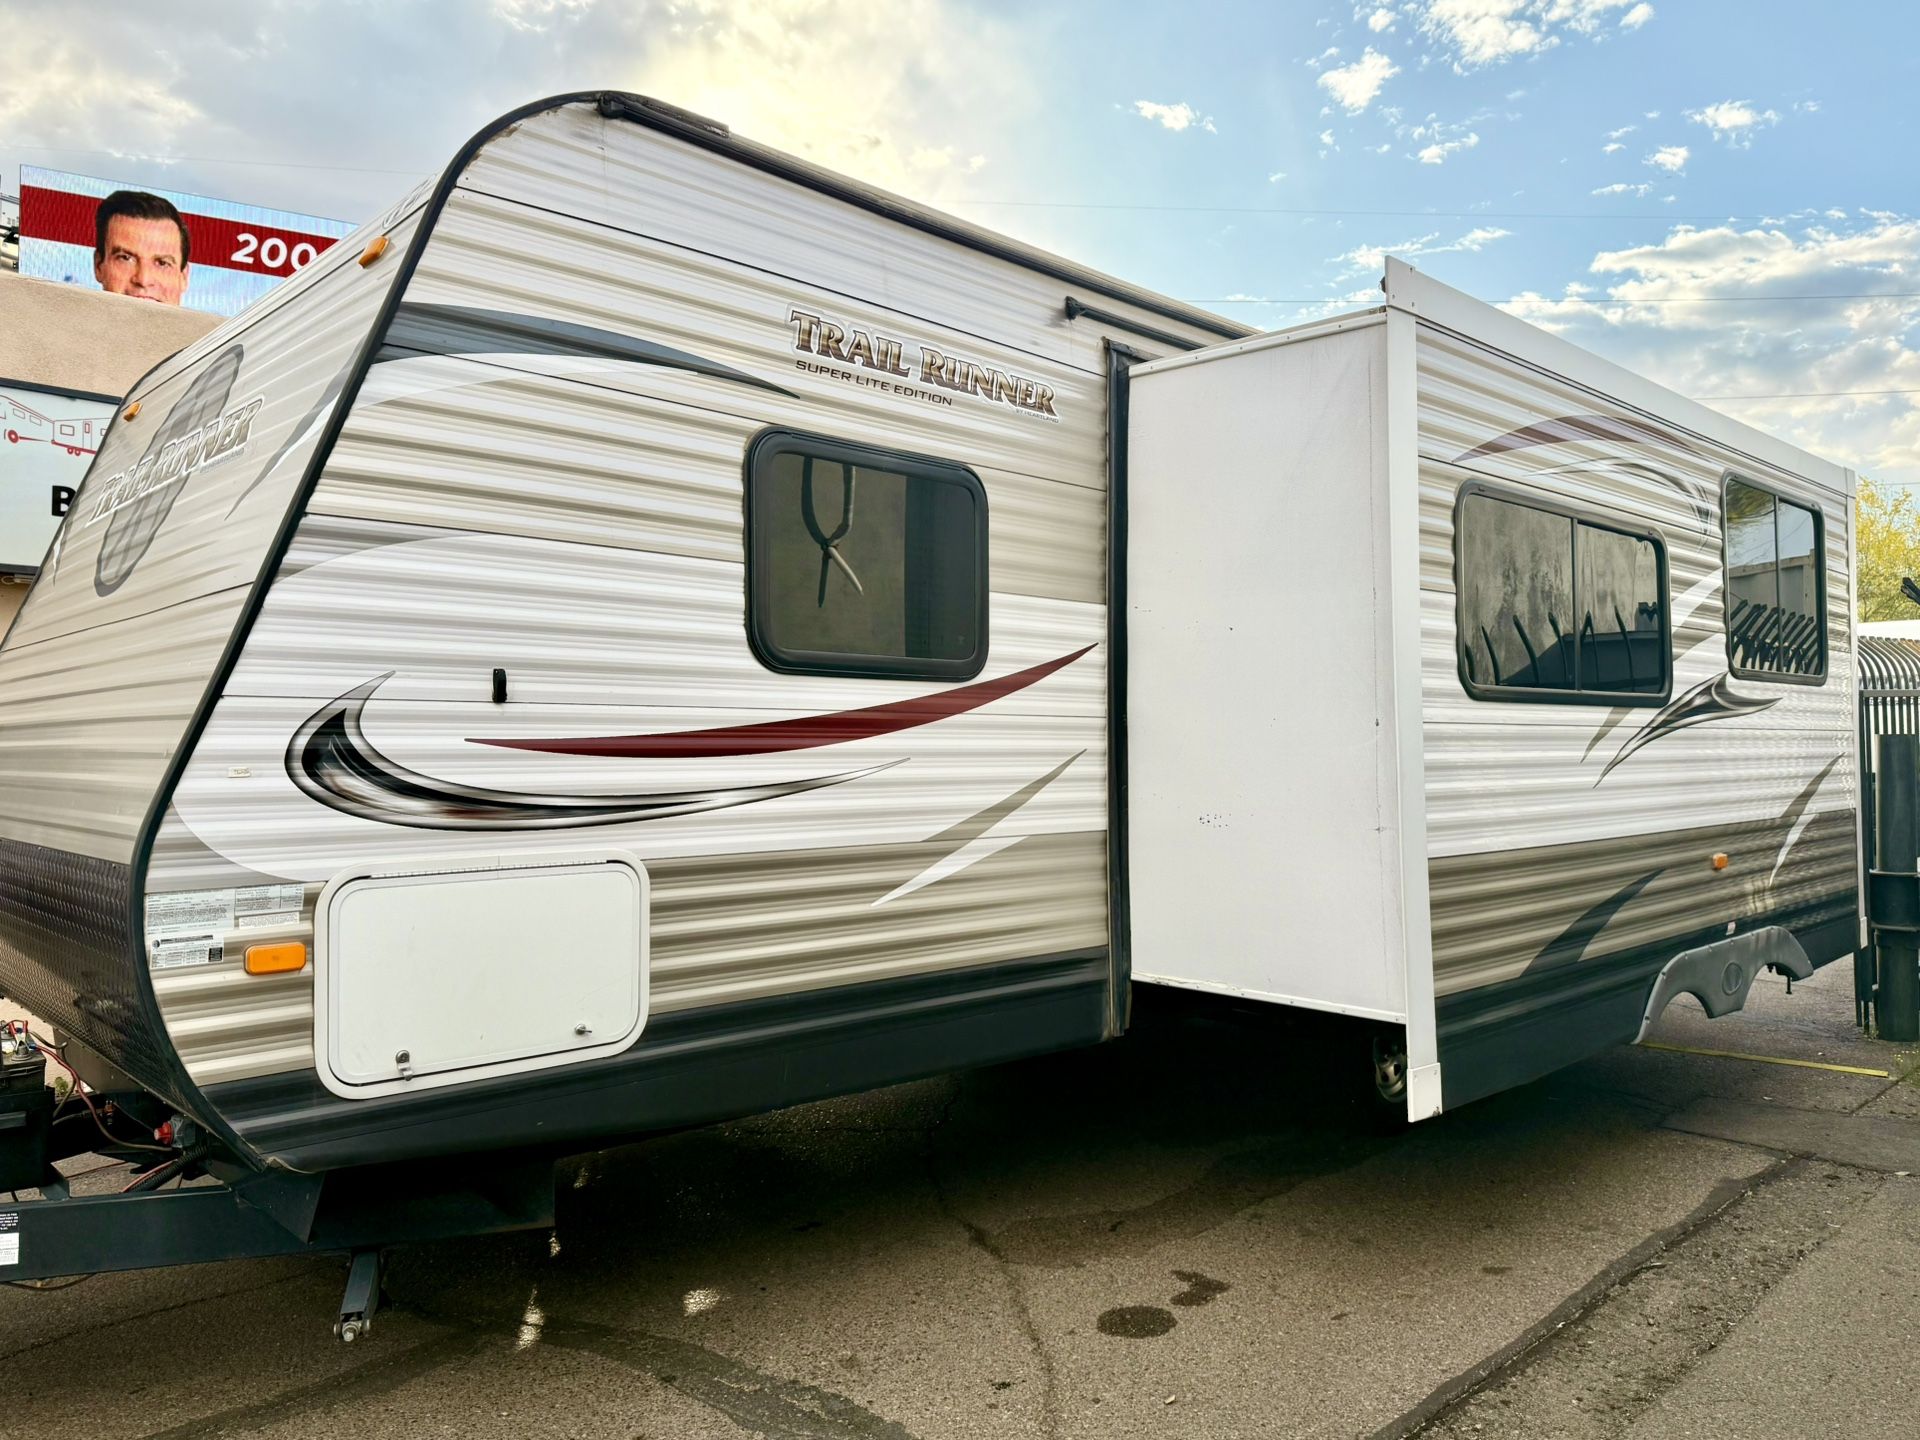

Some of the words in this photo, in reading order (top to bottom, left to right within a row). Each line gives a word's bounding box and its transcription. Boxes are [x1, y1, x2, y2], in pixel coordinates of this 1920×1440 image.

[790, 310, 911, 377] TRAIL
[920, 347, 1057, 416] RUNNER
[796, 360, 852, 382] SUPER
[856, 375, 890, 391] LITE
[894, 385, 952, 406] EDITION
[142, 397, 263, 494] RUNNER
